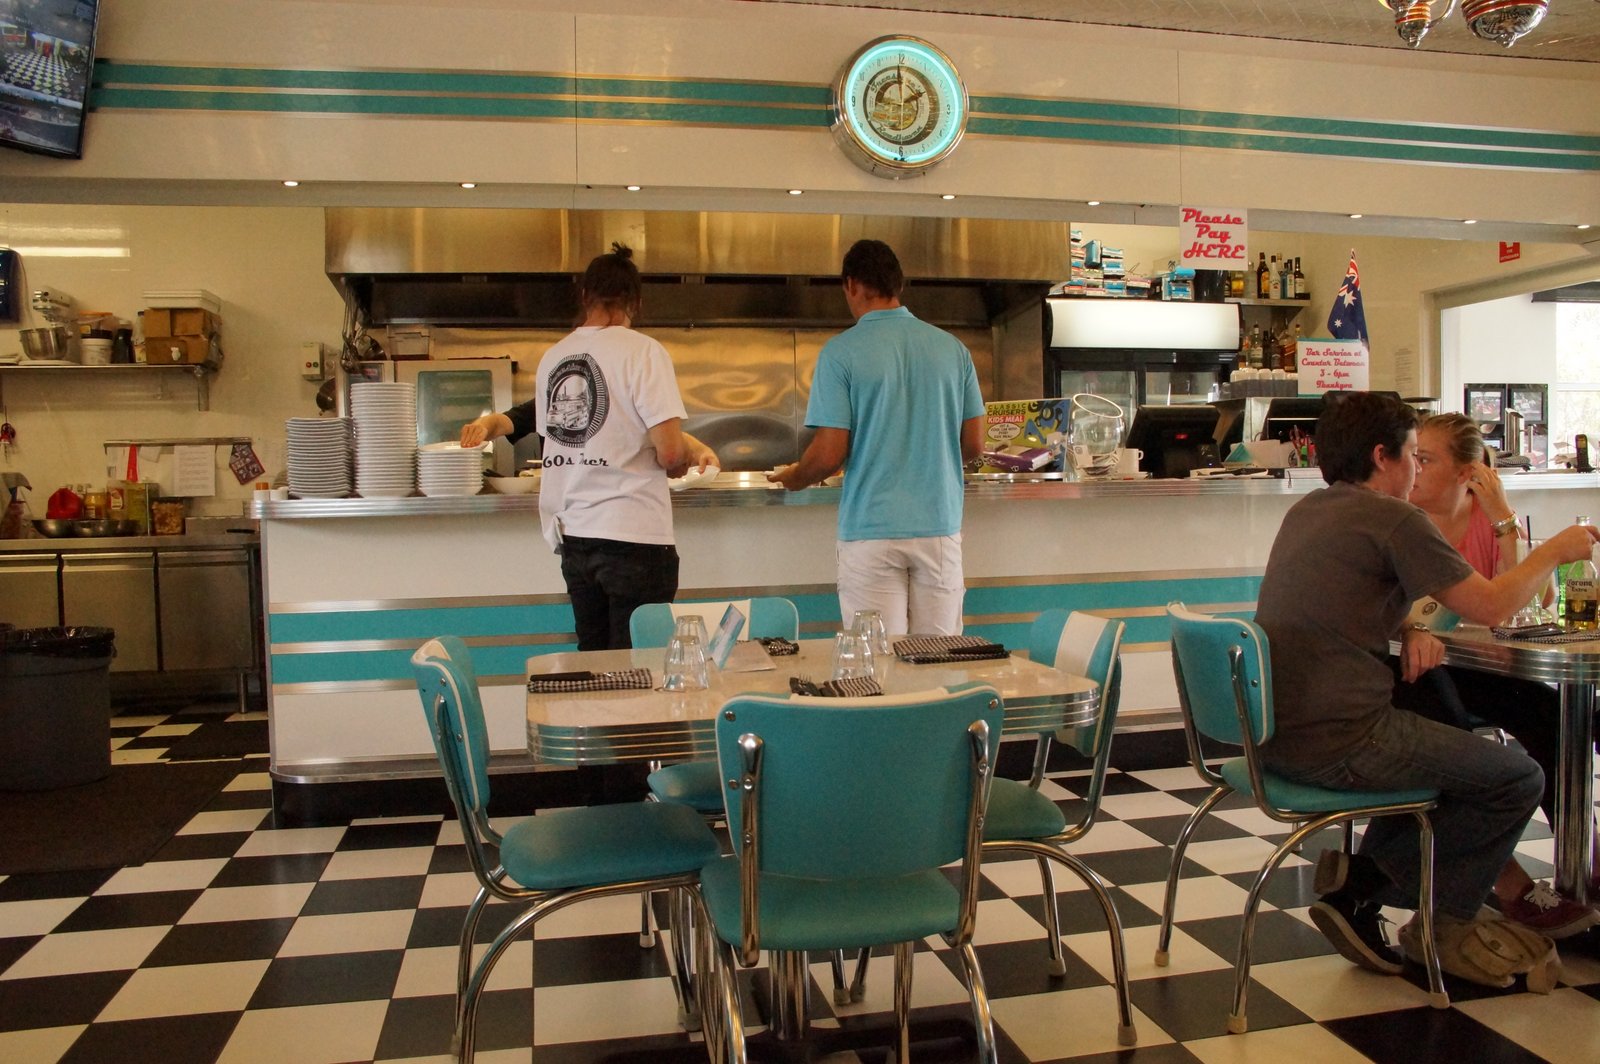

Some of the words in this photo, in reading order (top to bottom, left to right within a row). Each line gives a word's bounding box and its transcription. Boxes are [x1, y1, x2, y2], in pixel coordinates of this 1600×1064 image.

[898, 53, 906, 65] 12
[1181, 207, 1245, 225] Please
[1194, 223, 1232, 244] Pay
[1183, 242, 1246, 259] HERE
[1305, 347, 1320, 356] Bar
[1301, 357, 1332, 367] Counter
[1319, 368, 1326, 377] 3
[1333, 368, 1350, 379] 6pm
[987, 402, 1027, 410] CLASSIC
[987, 409, 1026, 417] CRUISERS
[987, 416, 1004, 424] KIDS
[1004, 415, 1024, 423] MEAL
[1566, 578, 1594, 588] Corona
